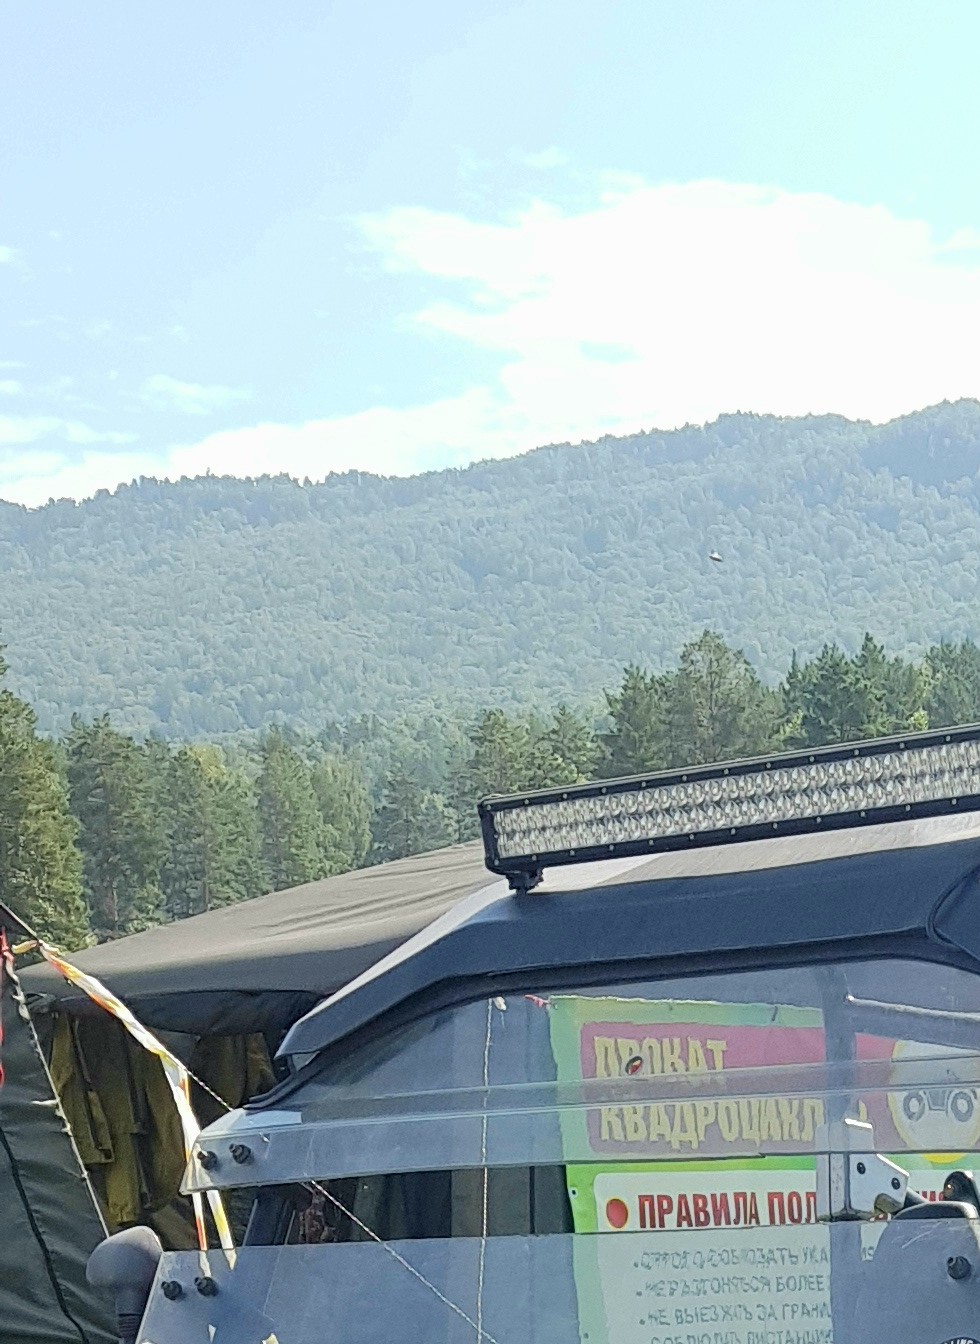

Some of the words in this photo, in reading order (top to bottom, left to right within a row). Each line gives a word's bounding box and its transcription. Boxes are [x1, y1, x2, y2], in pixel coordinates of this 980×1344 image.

[594, 1036, 728, 1079] ПРОКАТ
[601, 1099, 826, 1149] КВАДРОЦИКЛ
[638, 1192, 760, 1229] ПРАВИЛА
[767, 1191, 817, 1225] ПОЛ
[802, 1245, 829, 1265] УКА
[775, 1274, 826, 1293] БОЛЕЕ
[649, 1308, 671, 1326] НЕ
[756, 1304, 778, 1322] ЗА
[782, 1301, 831, 1321] ГРАНИ
